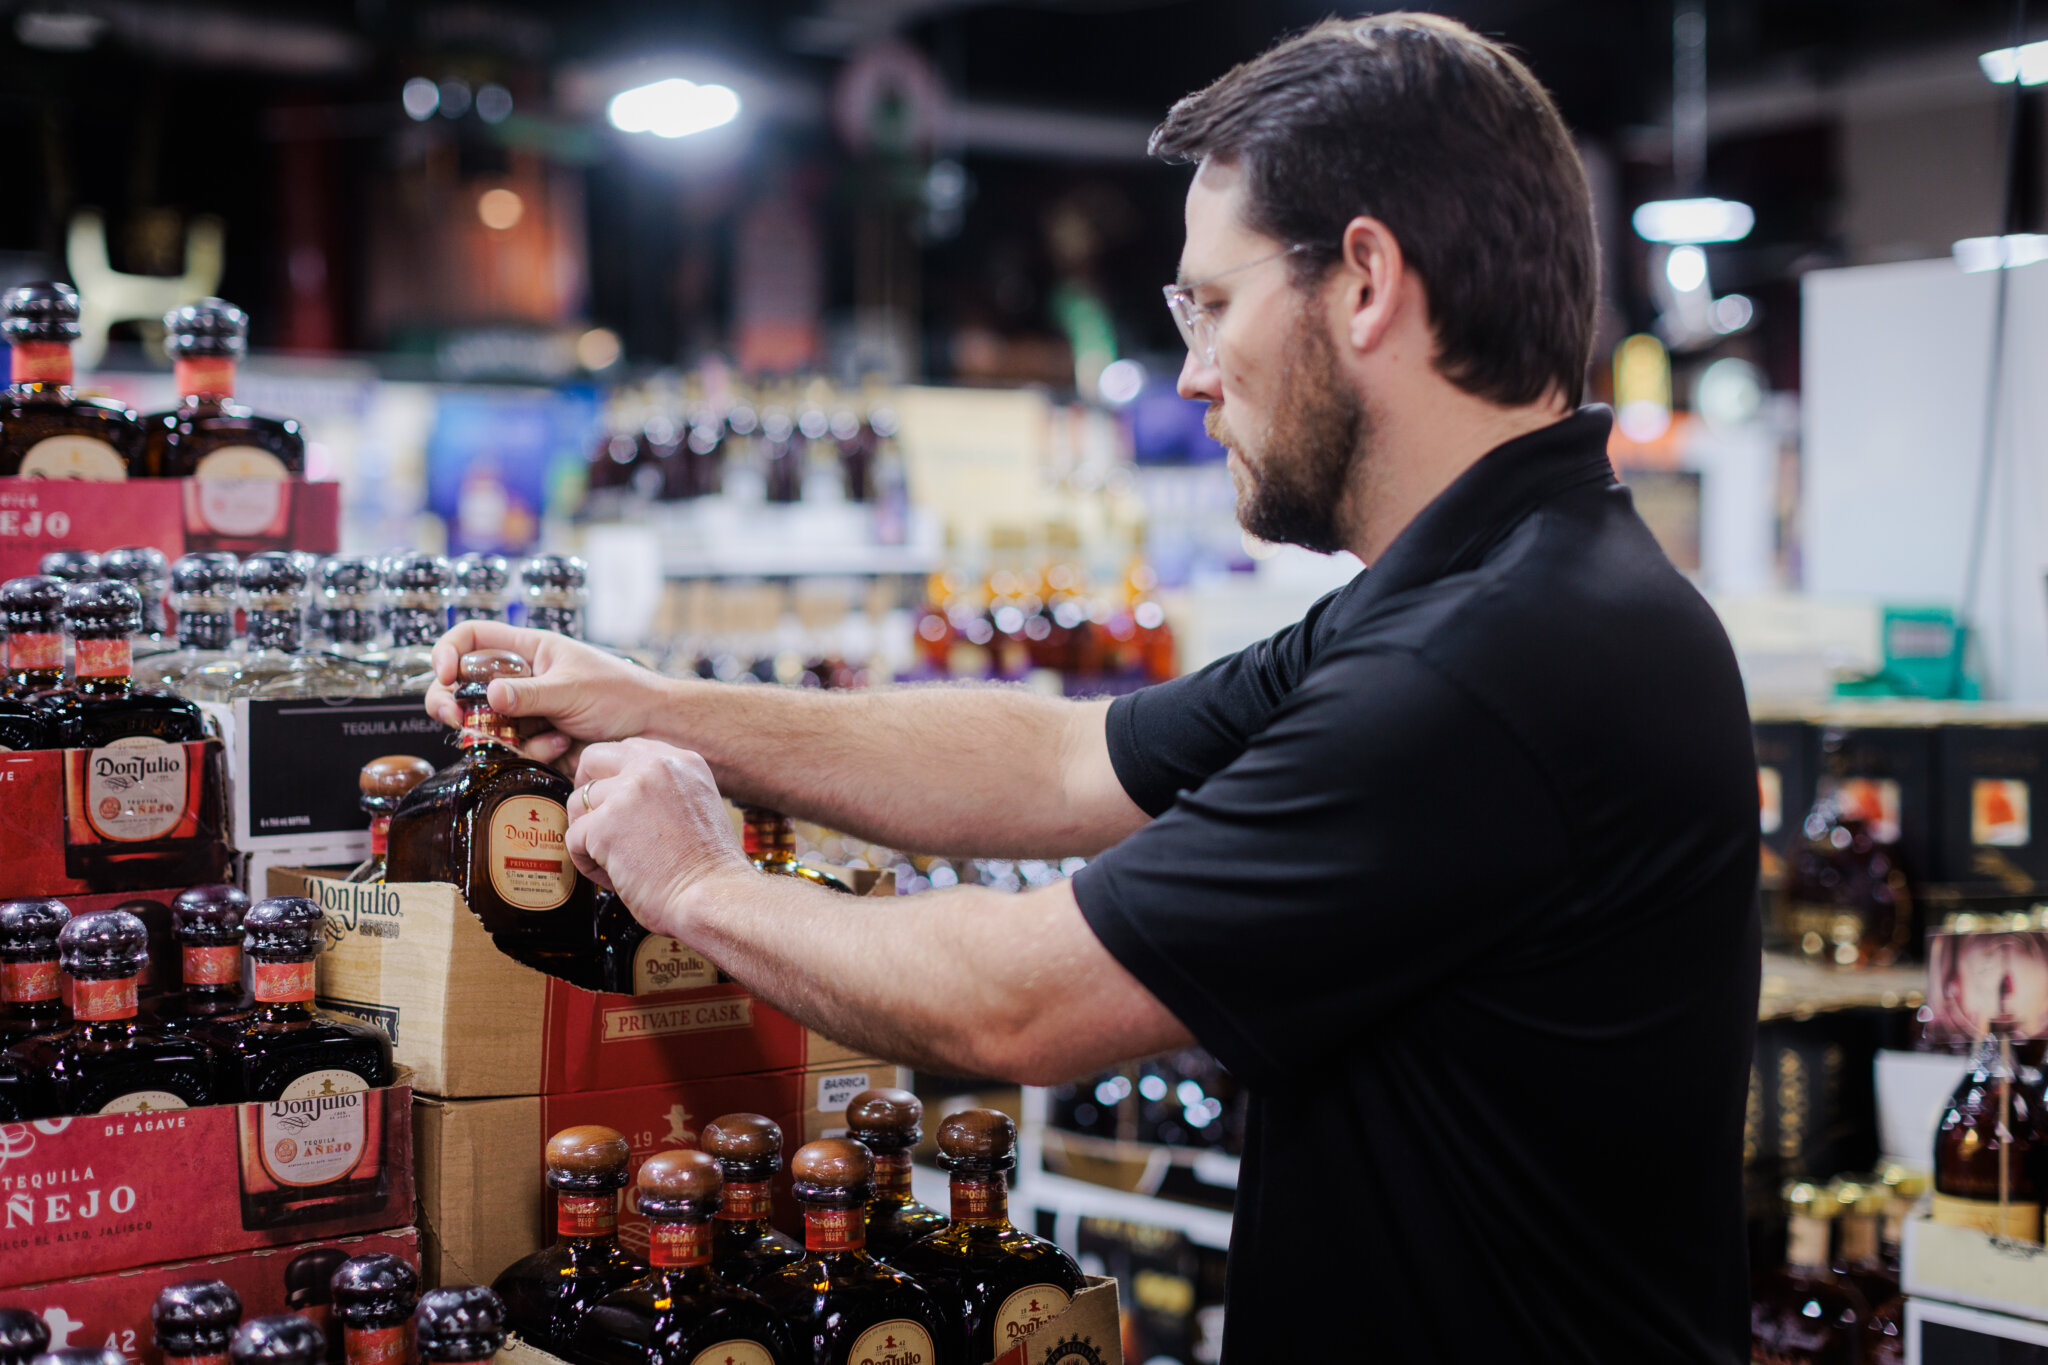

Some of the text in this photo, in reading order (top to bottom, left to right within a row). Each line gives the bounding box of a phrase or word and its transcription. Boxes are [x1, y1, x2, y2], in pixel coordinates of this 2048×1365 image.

[342, 722, 397, 736] TEQUILA
[617, 1004, 741, 1033] PRIVATE CASK
[824, 1076, 866, 1090] BARRICA
[105, 1117, 185, 1137] DE AGAVE
[633, 1130, 652, 1148] 19
[2, 1167, 95, 1191] TEQUILA
[0, 1239, 29, 1250] LCO
[35, 1236, 50, 1247] EL
[99, 1220, 153, 1238] JALISCO
[103, 1330, 136, 1353] 42
